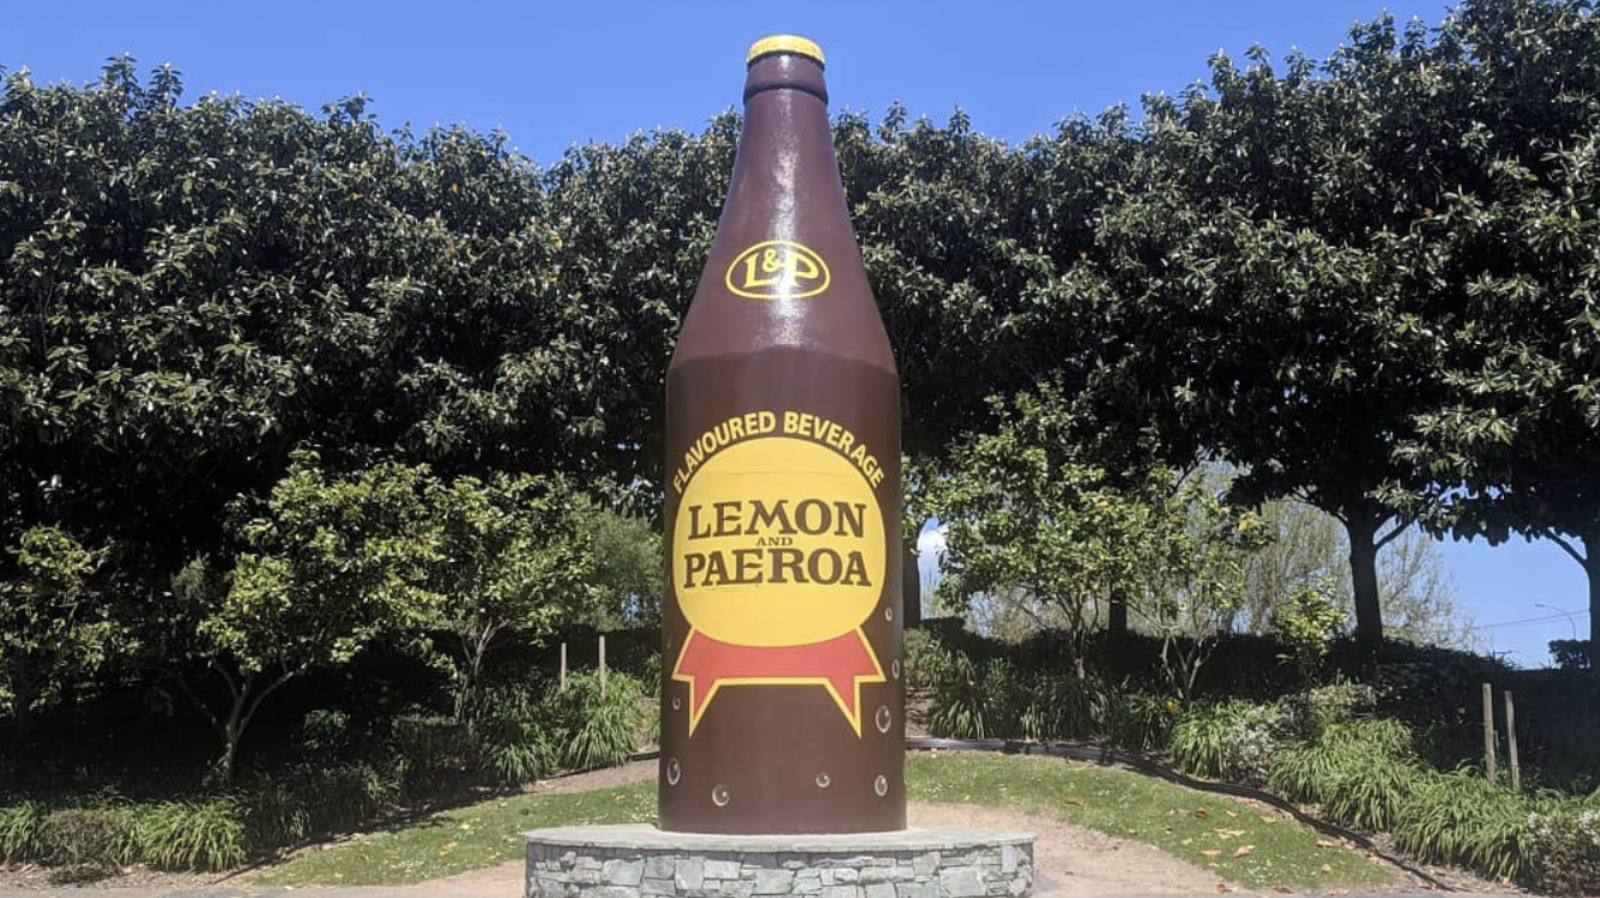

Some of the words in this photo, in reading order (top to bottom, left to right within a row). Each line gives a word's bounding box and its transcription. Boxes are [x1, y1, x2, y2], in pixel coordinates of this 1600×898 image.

[742, 248, 819, 288] L&P
[672, 410, 776, 494] FLAVOURED
[783, 410, 885, 488] BEVERAGE
[688, 498, 867, 540] LEMON
[755, 537, 793, 546] AND
[683, 547, 872, 588] PAEROA
